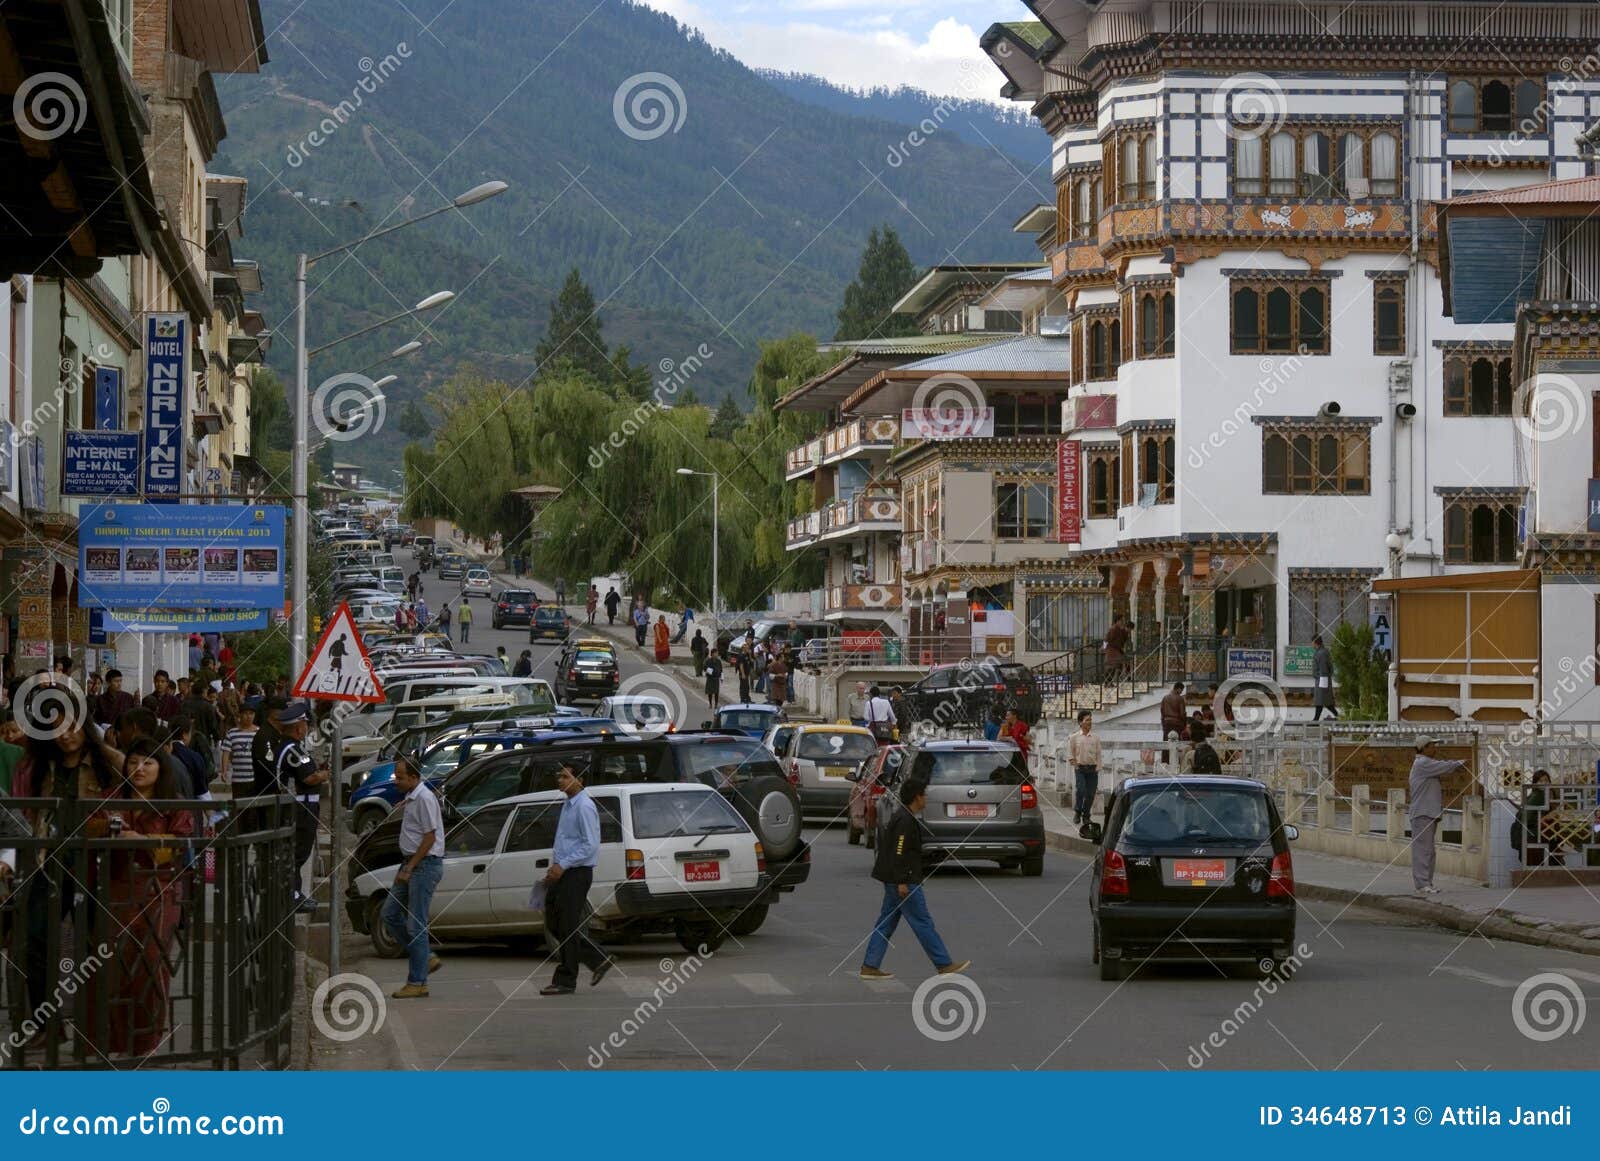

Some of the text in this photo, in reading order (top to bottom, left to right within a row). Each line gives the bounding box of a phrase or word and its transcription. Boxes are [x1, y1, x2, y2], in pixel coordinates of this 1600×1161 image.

[150, 341, 182, 356] HOTEL
[150, 362, 178, 479] NORLING
[66, 446, 137, 460] INTERNET
[76, 460, 127, 471] E-MAIL
[206, 469, 221, 481] 28
[1063, 442, 1076, 510] CHOPSTICK
[147, 484, 178, 492] THIMPHU
[175, 527, 204, 537] TALENT
[207, 527, 244, 537] FESTIVAL
[111, 611, 260, 622] TICKETS AVAILABLE AT AUDIO SHOP
